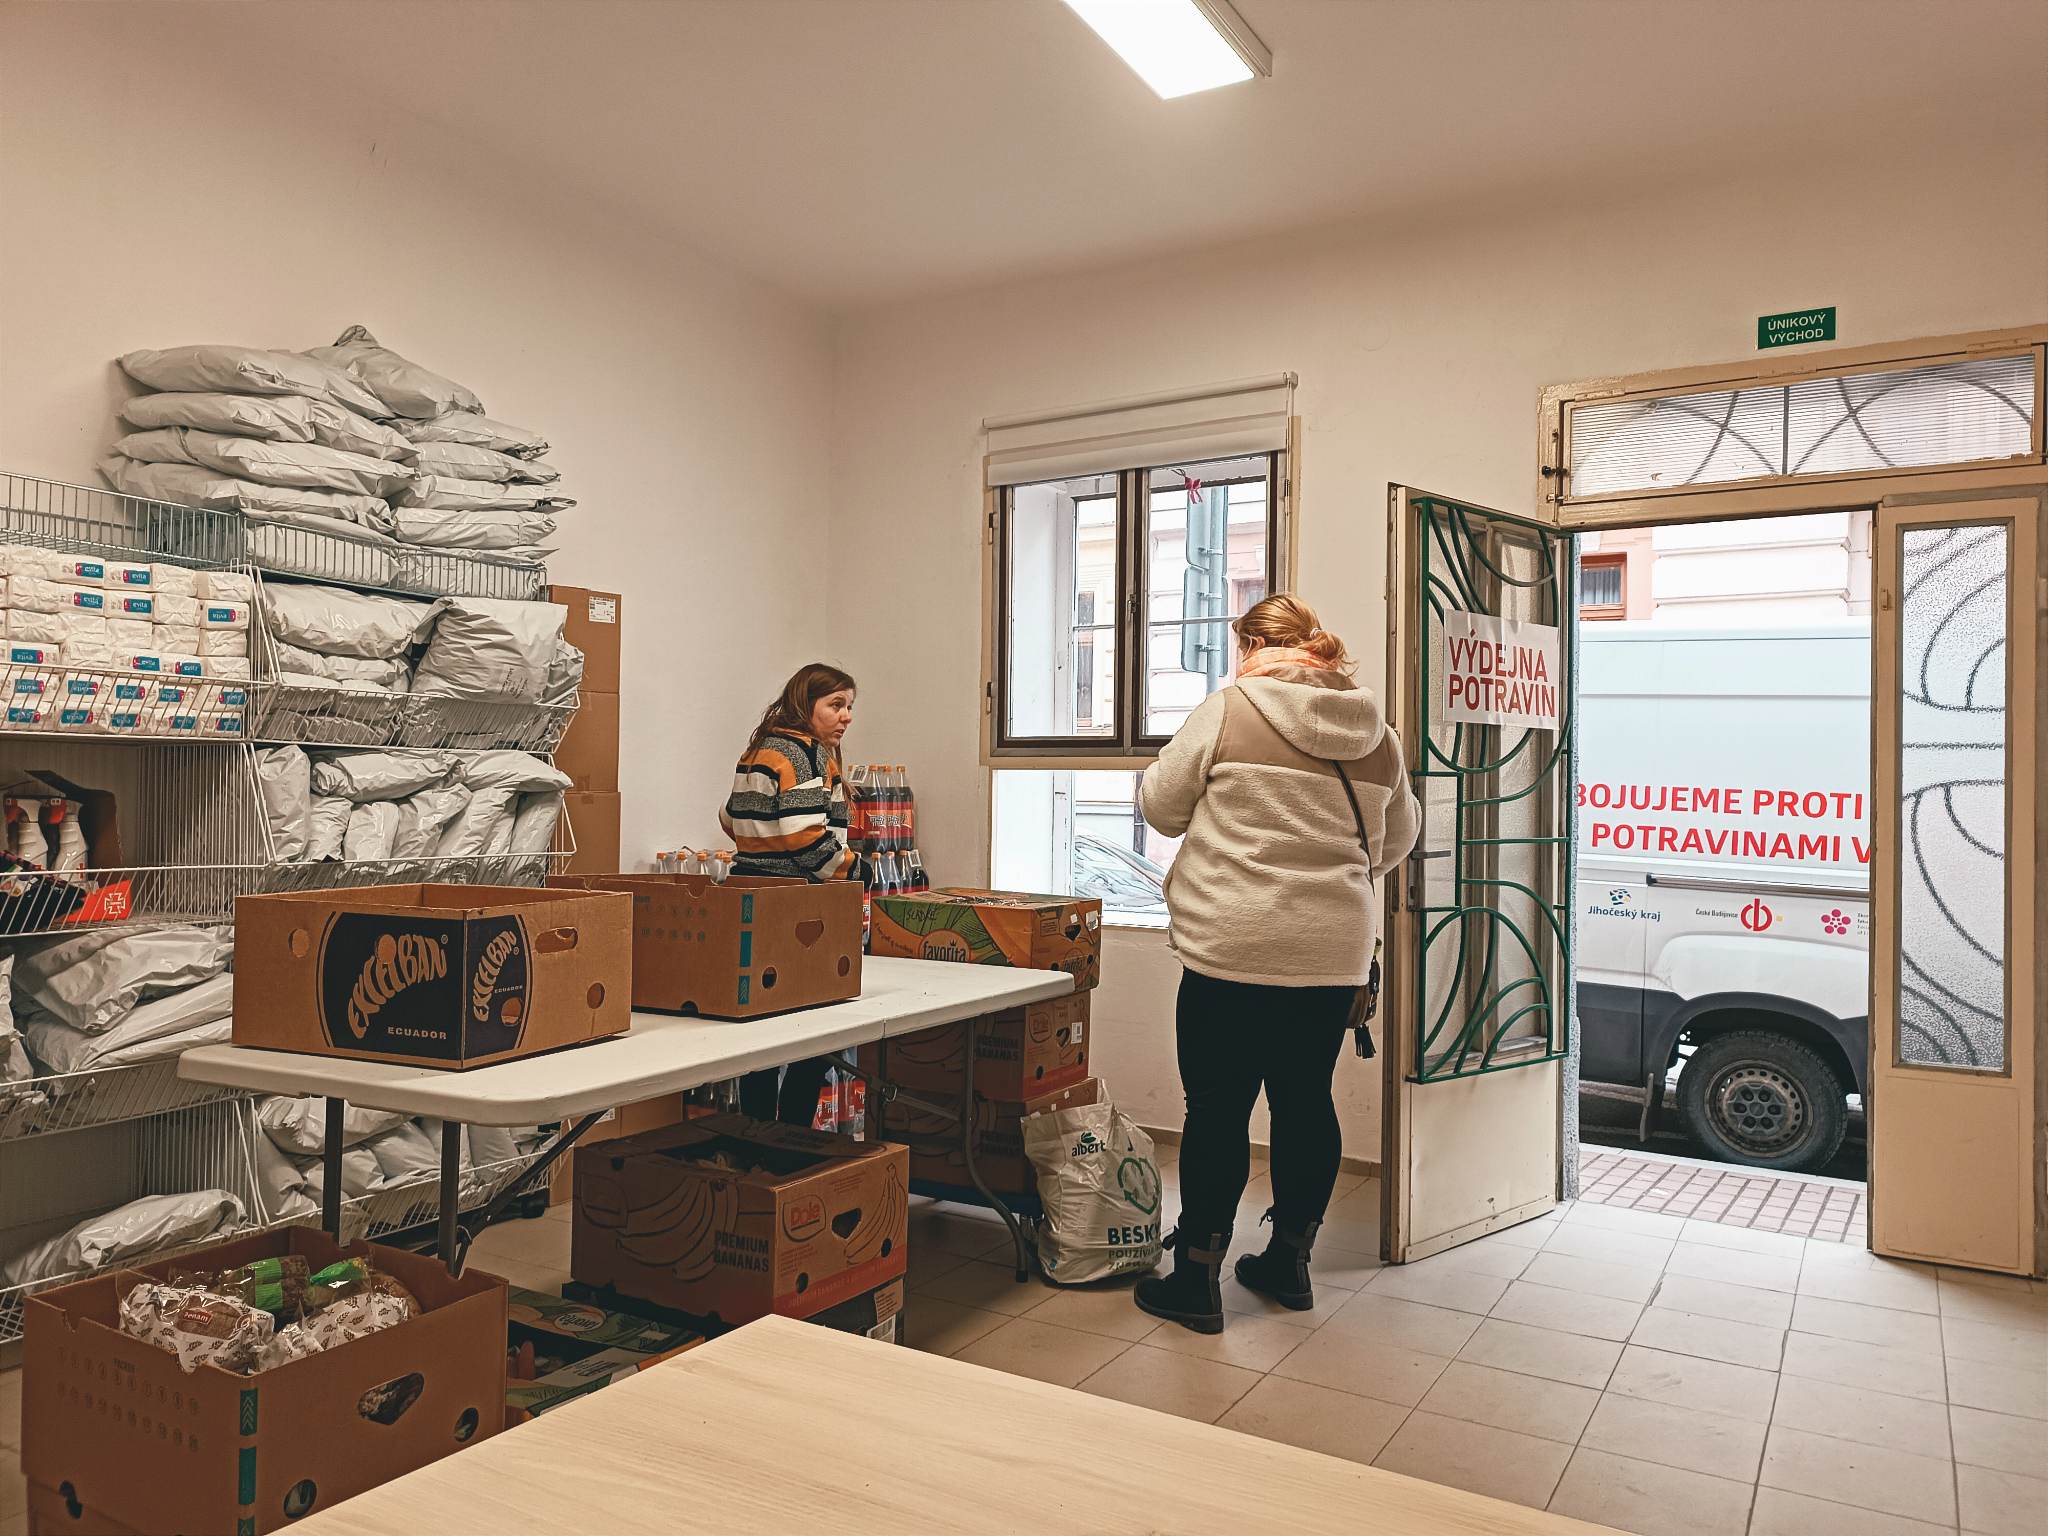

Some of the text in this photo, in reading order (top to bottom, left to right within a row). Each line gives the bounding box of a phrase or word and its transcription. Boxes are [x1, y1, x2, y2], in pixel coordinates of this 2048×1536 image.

[1768, 312, 1826, 330] ÚNIKOVÝ
[1769, 329, 1824, 343] VÝCHOD
[1449, 629, 1548, 682] VÝDEJNA
[1449, 674, 1555, 717] POTRAVIN
[1577, 783, 1862, 819] BOJUJEME PROTI
[1592, 823, 1840, 861] POTRAVINAMI
[1588, 905, 1661, 922] Jihočeský kraj
[494, 985, 523, 994] ECUADOR
[387, 1026, 447, 1040] ECUADOR
[1072, 1140, 1106, 1157] albert
[790, 1202, 820, 1227] Dole
[715, 1231, 769, 1254] PREMIUM
[714, 1248, 769, 1272] BANANAS
